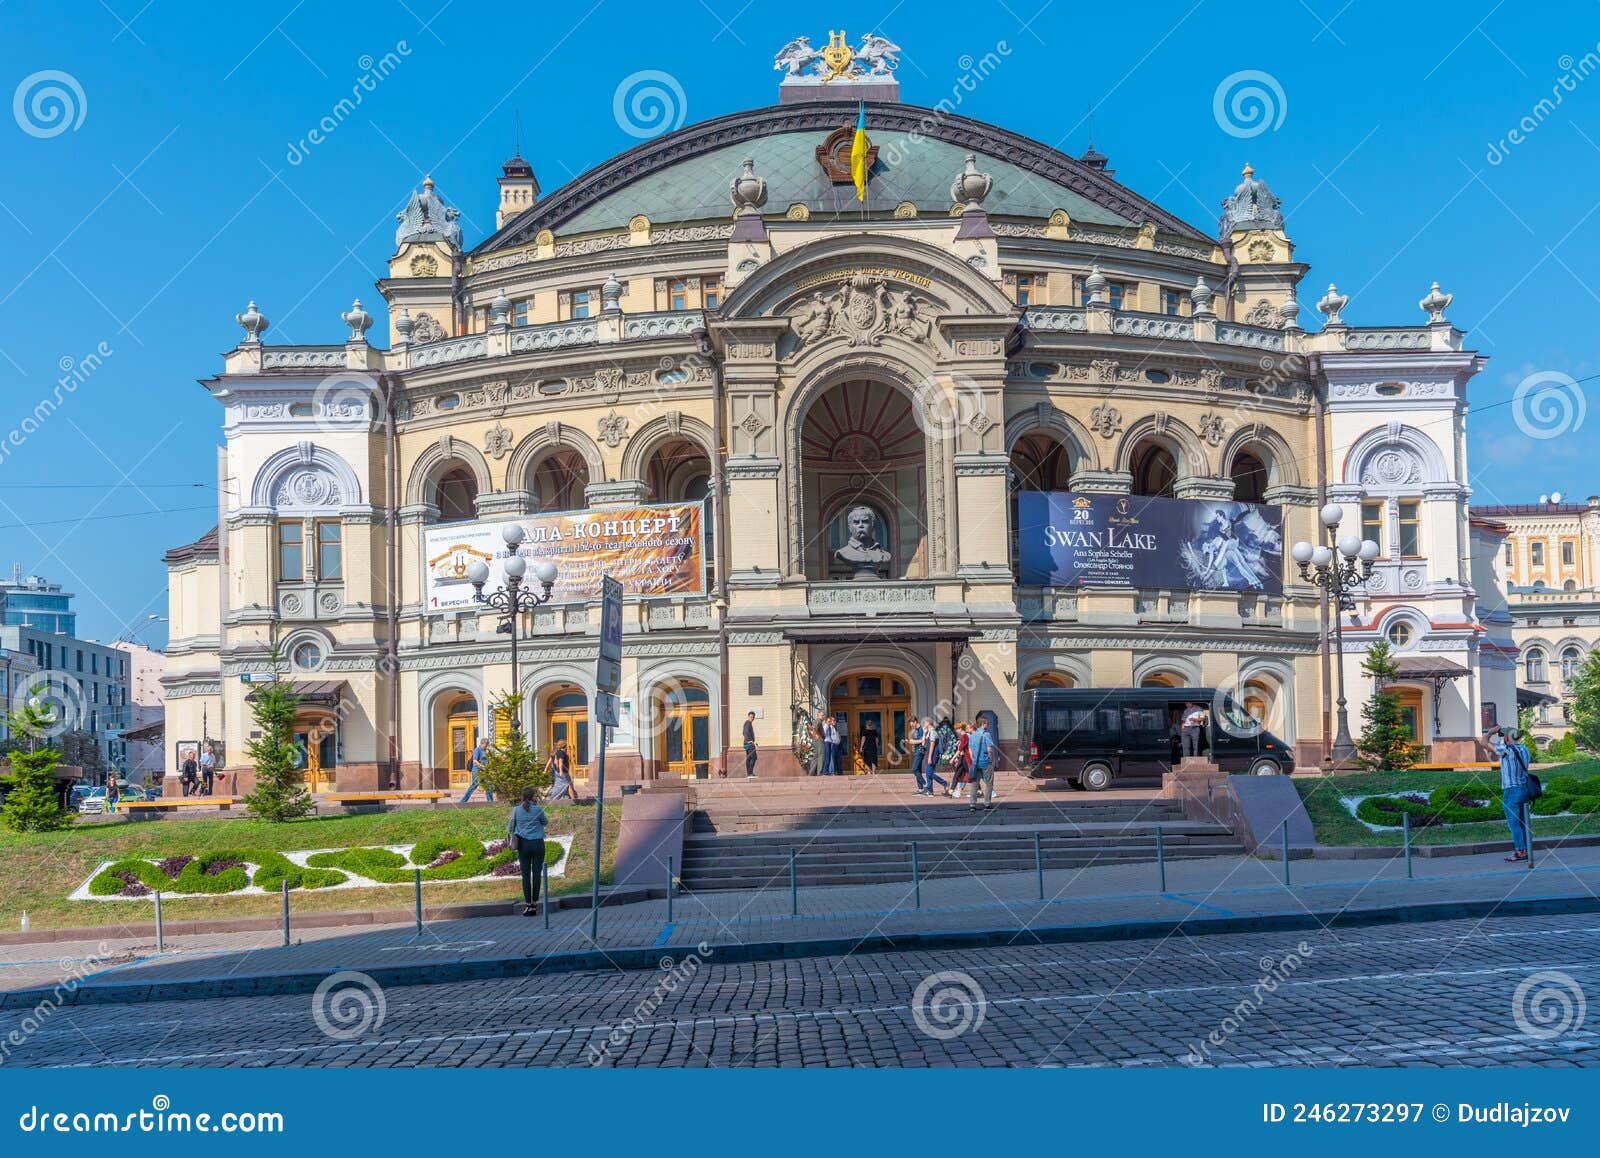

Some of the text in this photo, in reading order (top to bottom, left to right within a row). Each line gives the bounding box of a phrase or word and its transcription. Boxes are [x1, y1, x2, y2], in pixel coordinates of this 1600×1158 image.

[1074, 509, 1090, 520] 20
[520, 517, 681, 543] АЛА-КОНЦЕРТ
[665, 536, 695, 546] сезону
[431, 596, 438, 608] 1
